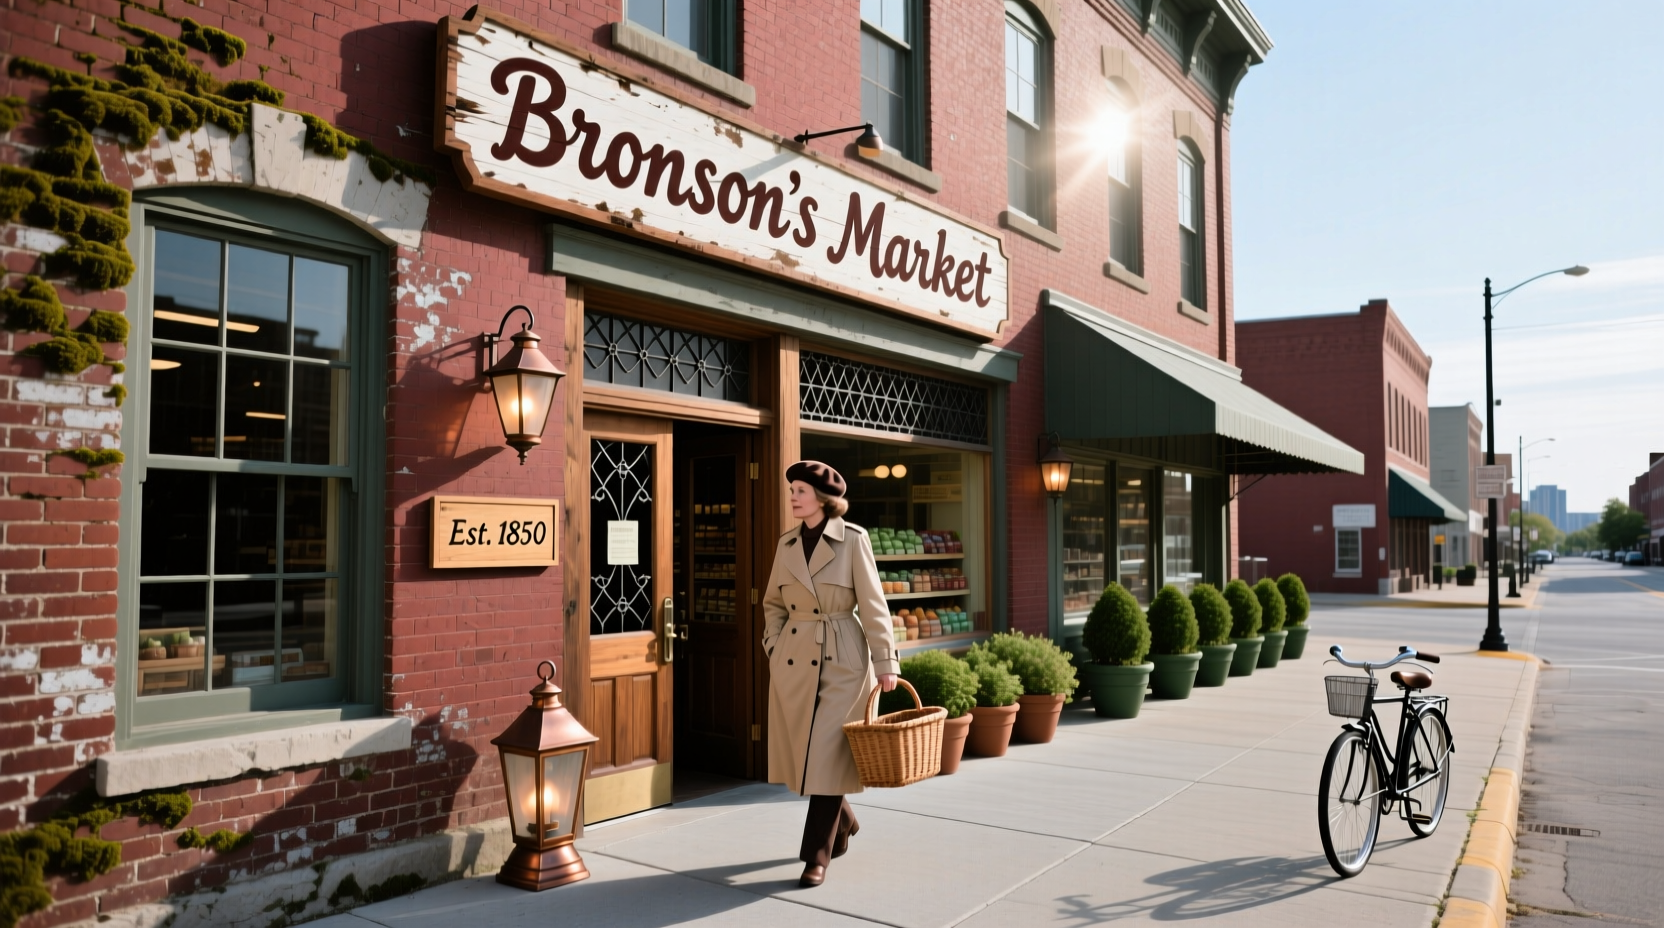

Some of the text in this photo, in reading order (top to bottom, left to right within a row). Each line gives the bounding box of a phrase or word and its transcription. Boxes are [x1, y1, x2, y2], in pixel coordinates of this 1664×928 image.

[490, 56, 992, 307] Bronson's Market
[448, 519, 547, 546] Est. 1850
